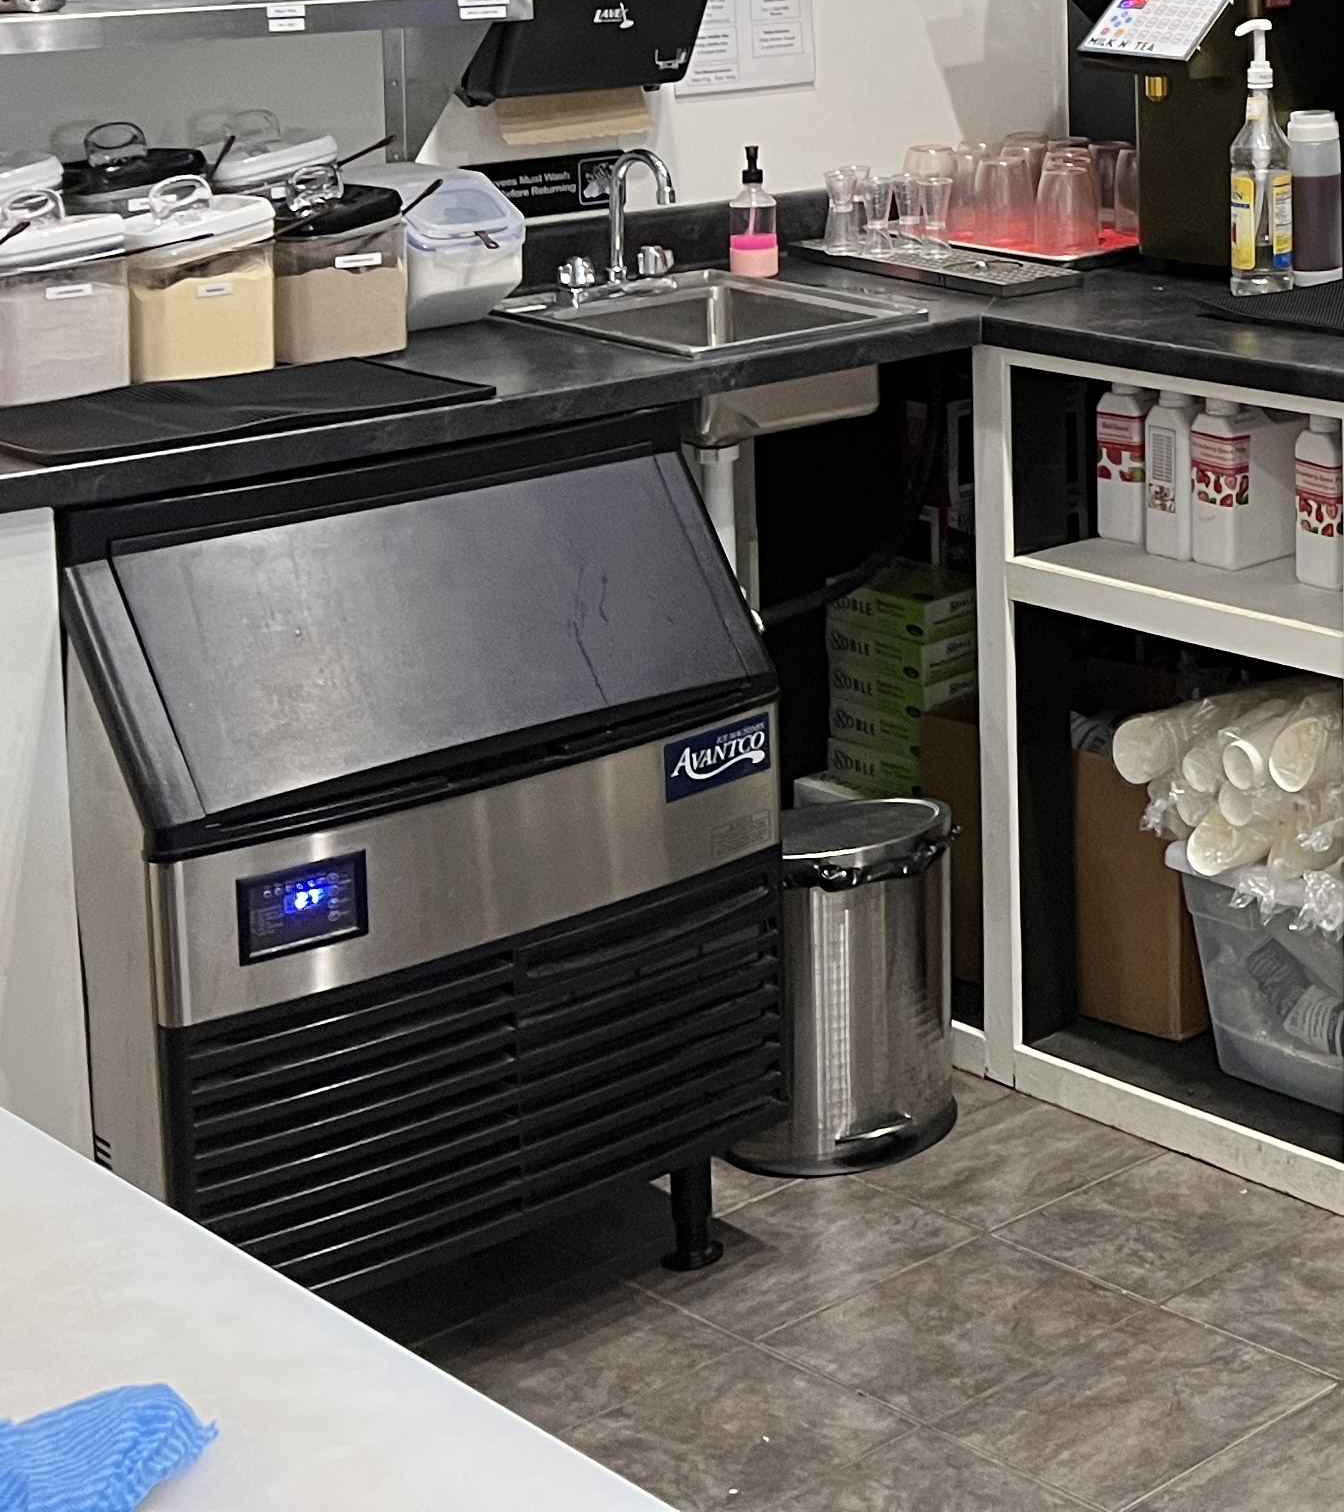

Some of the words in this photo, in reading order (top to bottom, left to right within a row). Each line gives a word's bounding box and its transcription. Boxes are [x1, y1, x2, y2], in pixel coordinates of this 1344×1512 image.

[1088, 37, 1113, 48] MILK
[1135, 41, 1155, 52] TEA
[519, 174, 543, 185] Must
[544, 170, 571, 183] Wash
[531, 183, 577, 196] Returning
[671, 731, 766, 779] AVANTCO
